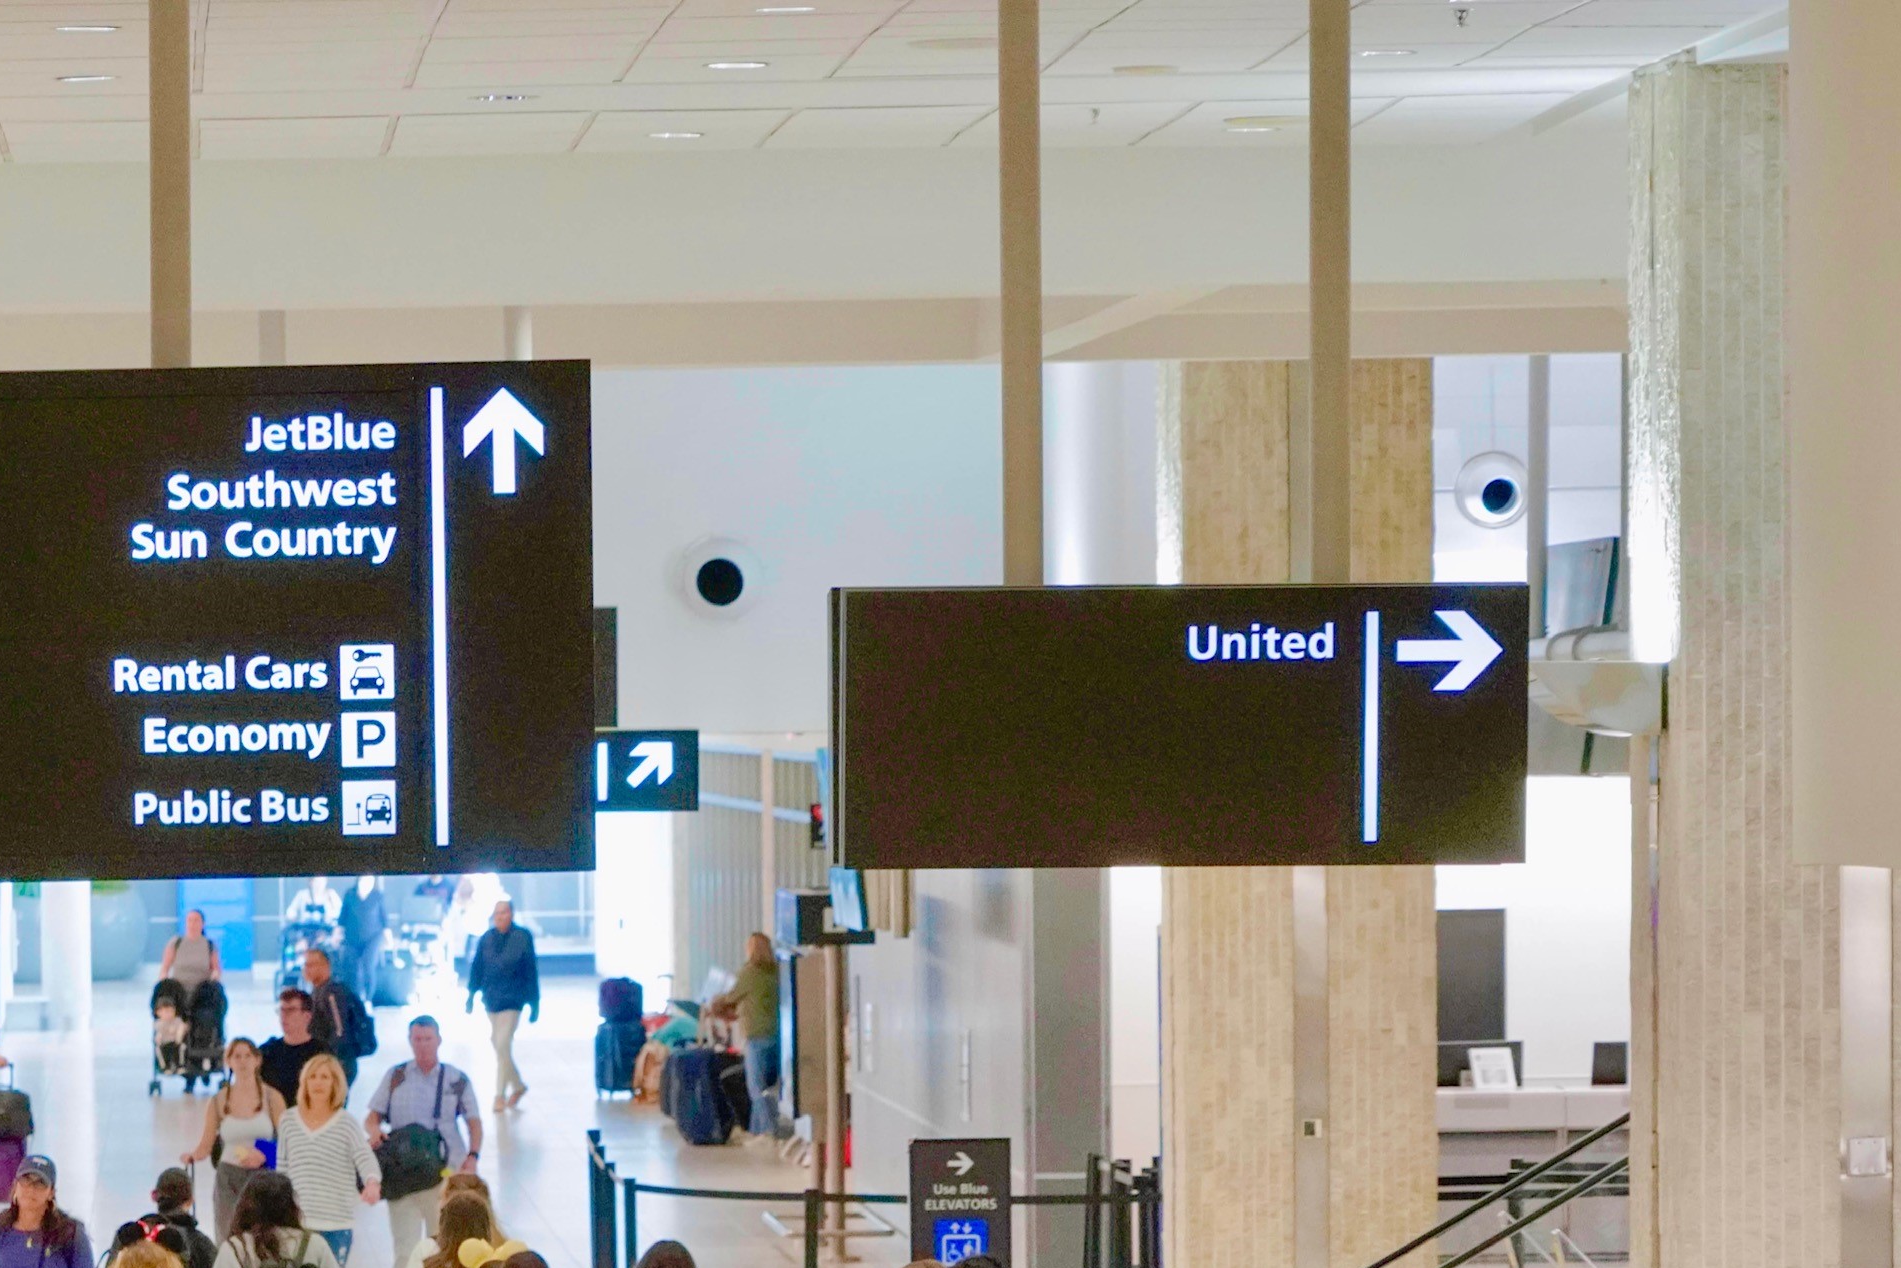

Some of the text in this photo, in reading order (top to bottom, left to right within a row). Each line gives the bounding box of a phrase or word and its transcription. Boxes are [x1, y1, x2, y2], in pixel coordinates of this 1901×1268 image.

[245, 412, 396, 452] JetBlue
[167, 470, 397, 511] Southwest
[131, 521, 397, 564] Sun Country
[1188, 621, 1334, 661] United
[113, 655, 329, 692] Rental Cars
[143, 717, 332, 760] Economy
[134, 789, 330, 825] Public Bus
[924, 1197, 998, 1211] ELEVATORS
[932, 1182, 989, 1195] Use Blue
